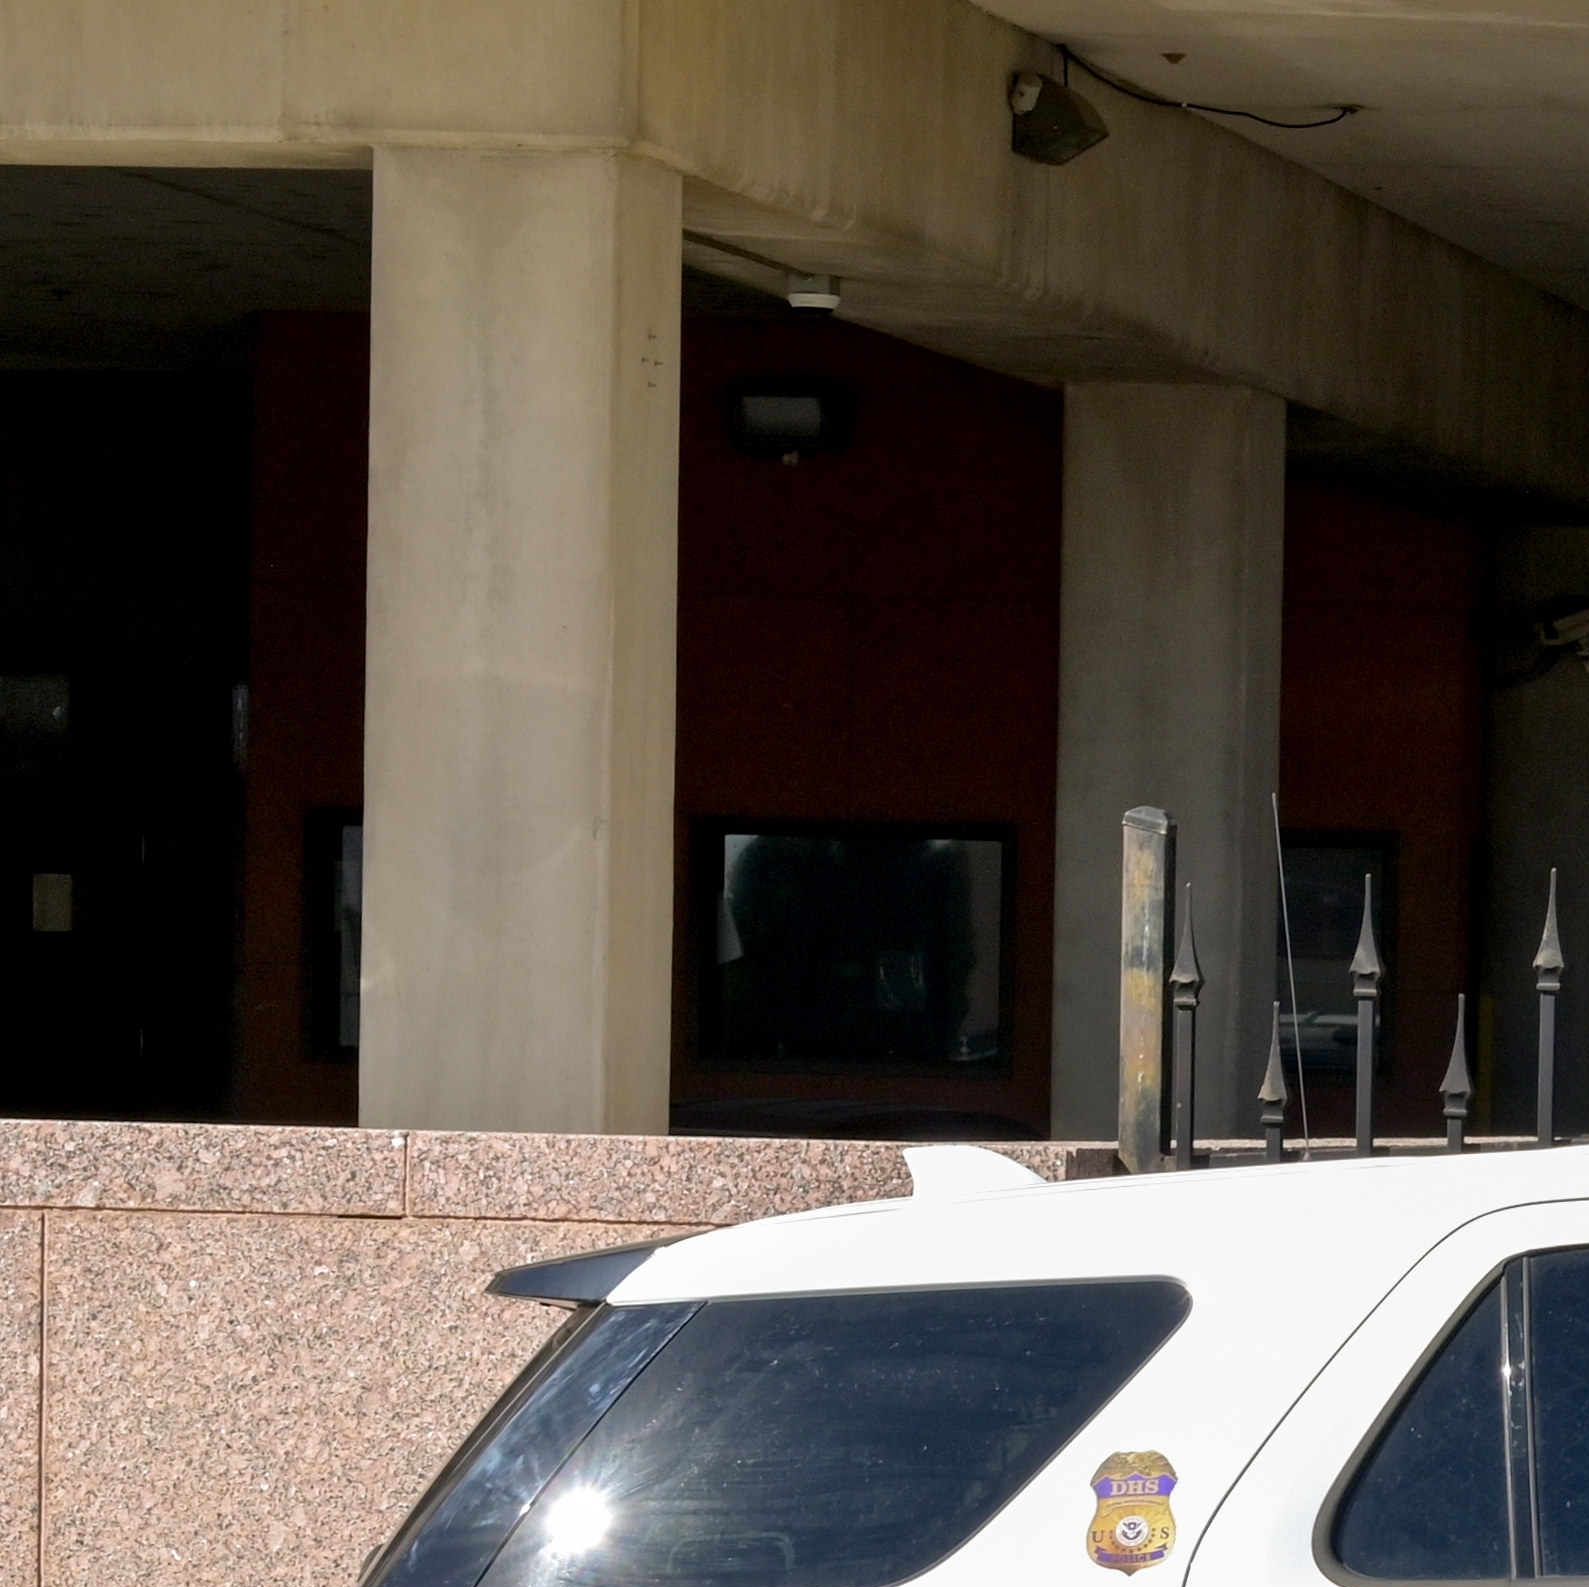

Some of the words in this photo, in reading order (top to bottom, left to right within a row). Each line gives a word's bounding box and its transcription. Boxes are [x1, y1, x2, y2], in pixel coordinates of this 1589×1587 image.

[1110, 1479, 1160, 1496] DHS
[1092, 1531, 1106, 1544] U
[1159, 1526, 1170, 1540] S
